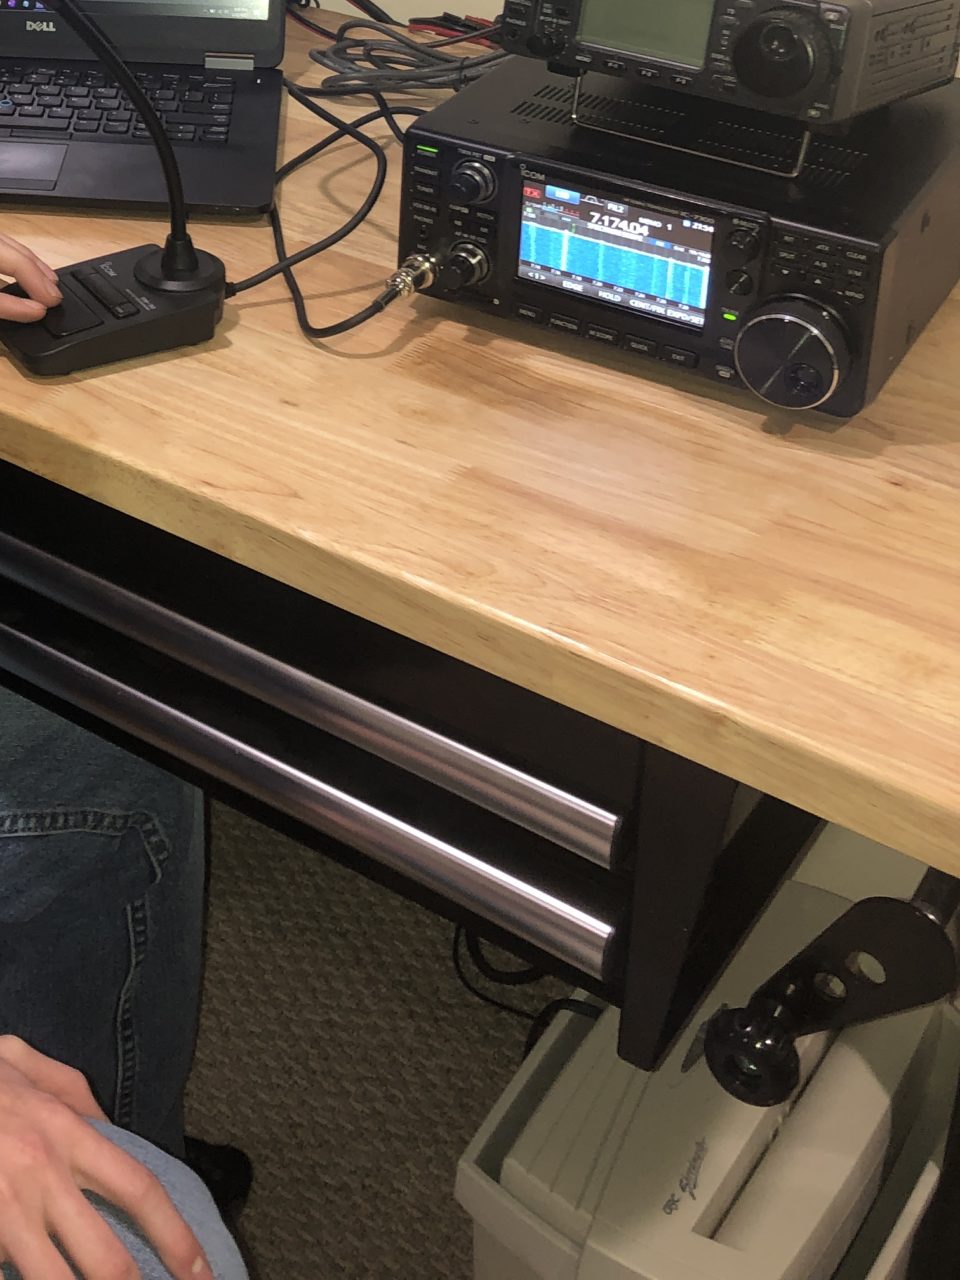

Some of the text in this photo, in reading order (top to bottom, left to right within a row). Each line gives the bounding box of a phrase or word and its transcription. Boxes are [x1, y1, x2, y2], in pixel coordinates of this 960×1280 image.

[26, 21, 56, 32] DELL
[520, 164, 545, 181] ICOM
[525, 188, 540, 198] TX
[562, 280, 584, 292] EDGE
[598, 291, 622, 302] HOLD
[672, 354, 686, 362] EXIT
